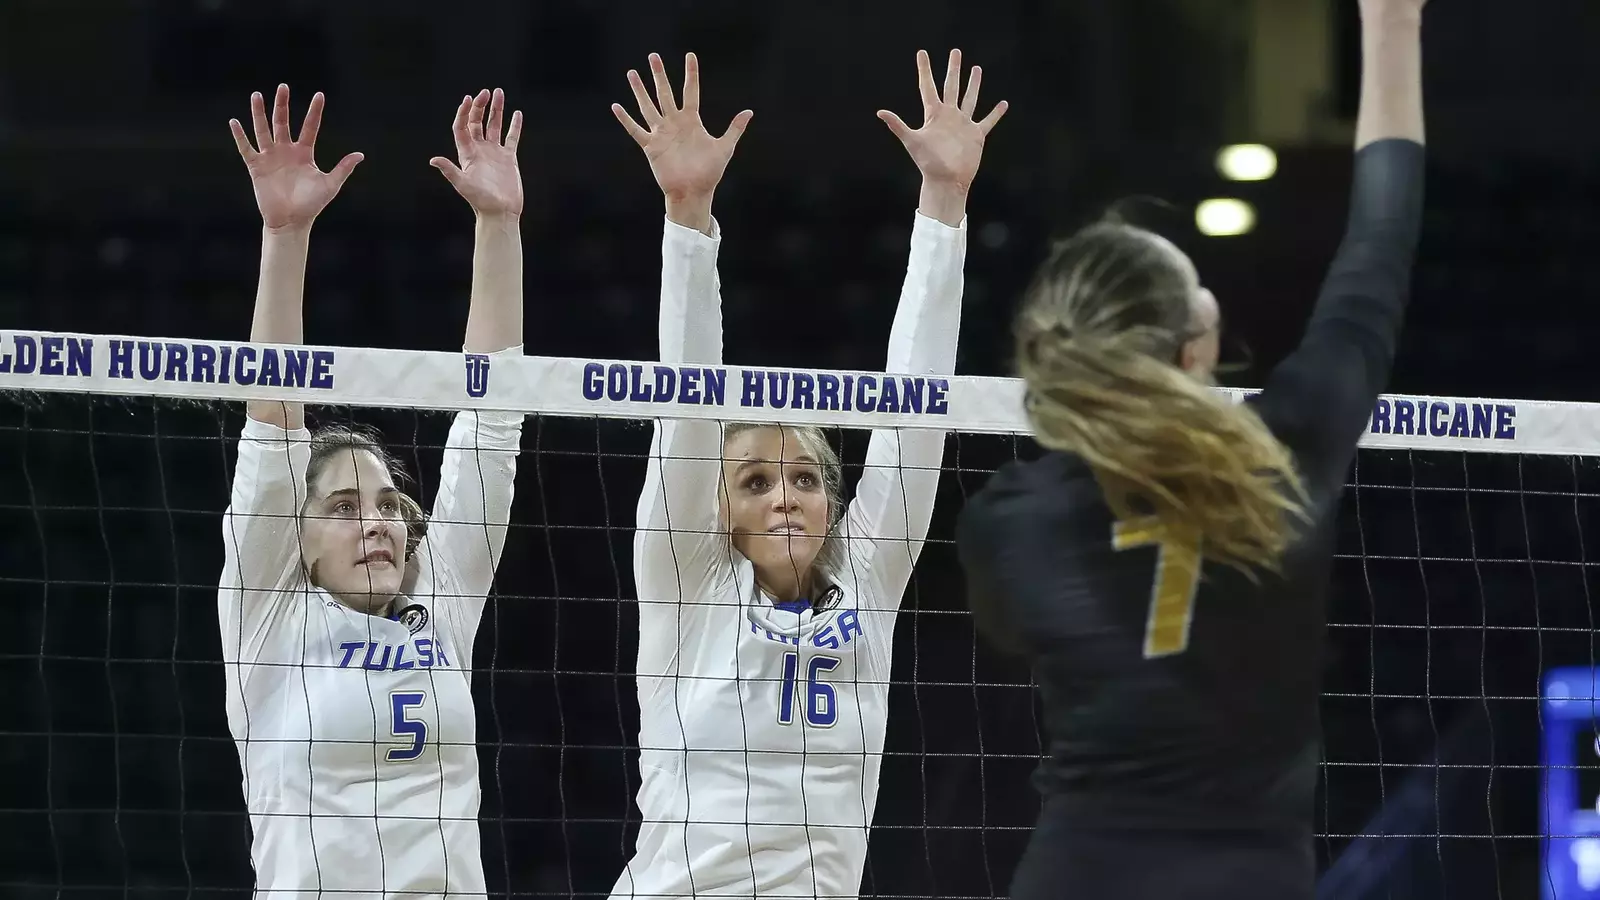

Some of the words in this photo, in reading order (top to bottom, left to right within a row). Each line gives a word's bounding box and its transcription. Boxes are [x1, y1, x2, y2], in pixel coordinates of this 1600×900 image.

[108, 340, 335, 389] HURRICANE
[582, 362, 727, 405] GOLDEN
[740, 370, 949, 414] HURRICANE
[1110, 514, 1203, 659] 7
[339, 639, 450, 671] TULSA
[778, 652, 841, 728] 16
[386, 691, 429, 761] 5
